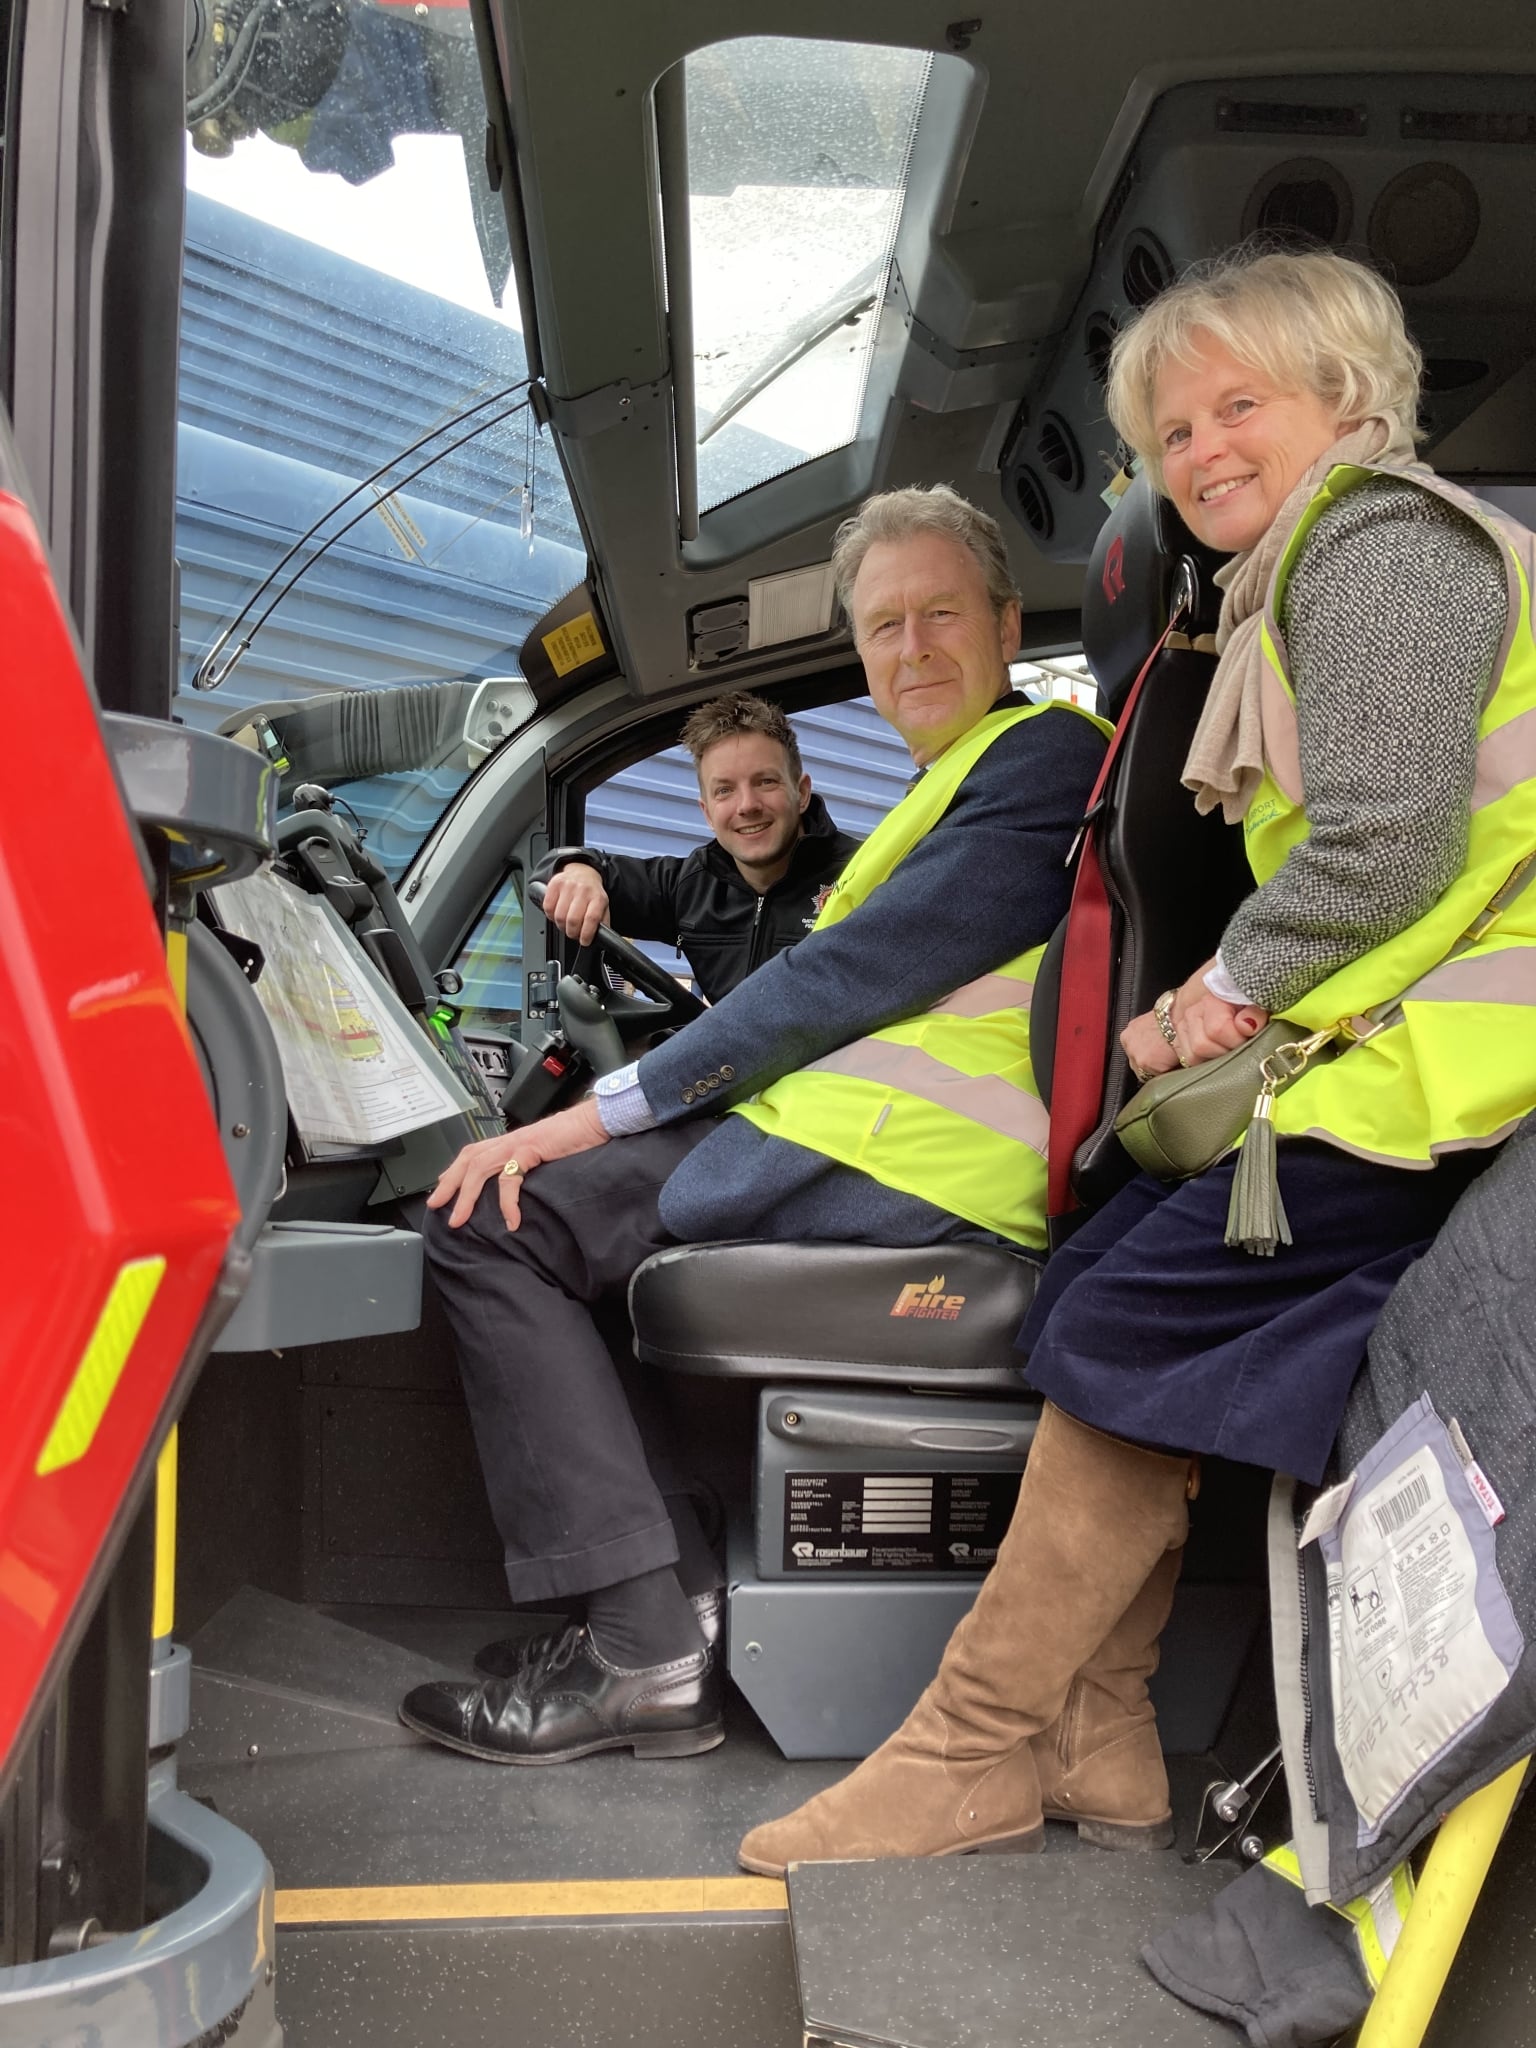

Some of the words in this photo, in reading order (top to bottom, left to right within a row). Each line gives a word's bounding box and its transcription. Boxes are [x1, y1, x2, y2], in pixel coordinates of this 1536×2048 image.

[906, 1308, 960, 1320] FIGHTER
[1473, 1474, 1496, 1510] TITAN
[815, 1541, 869, 1558] rosenbauer
